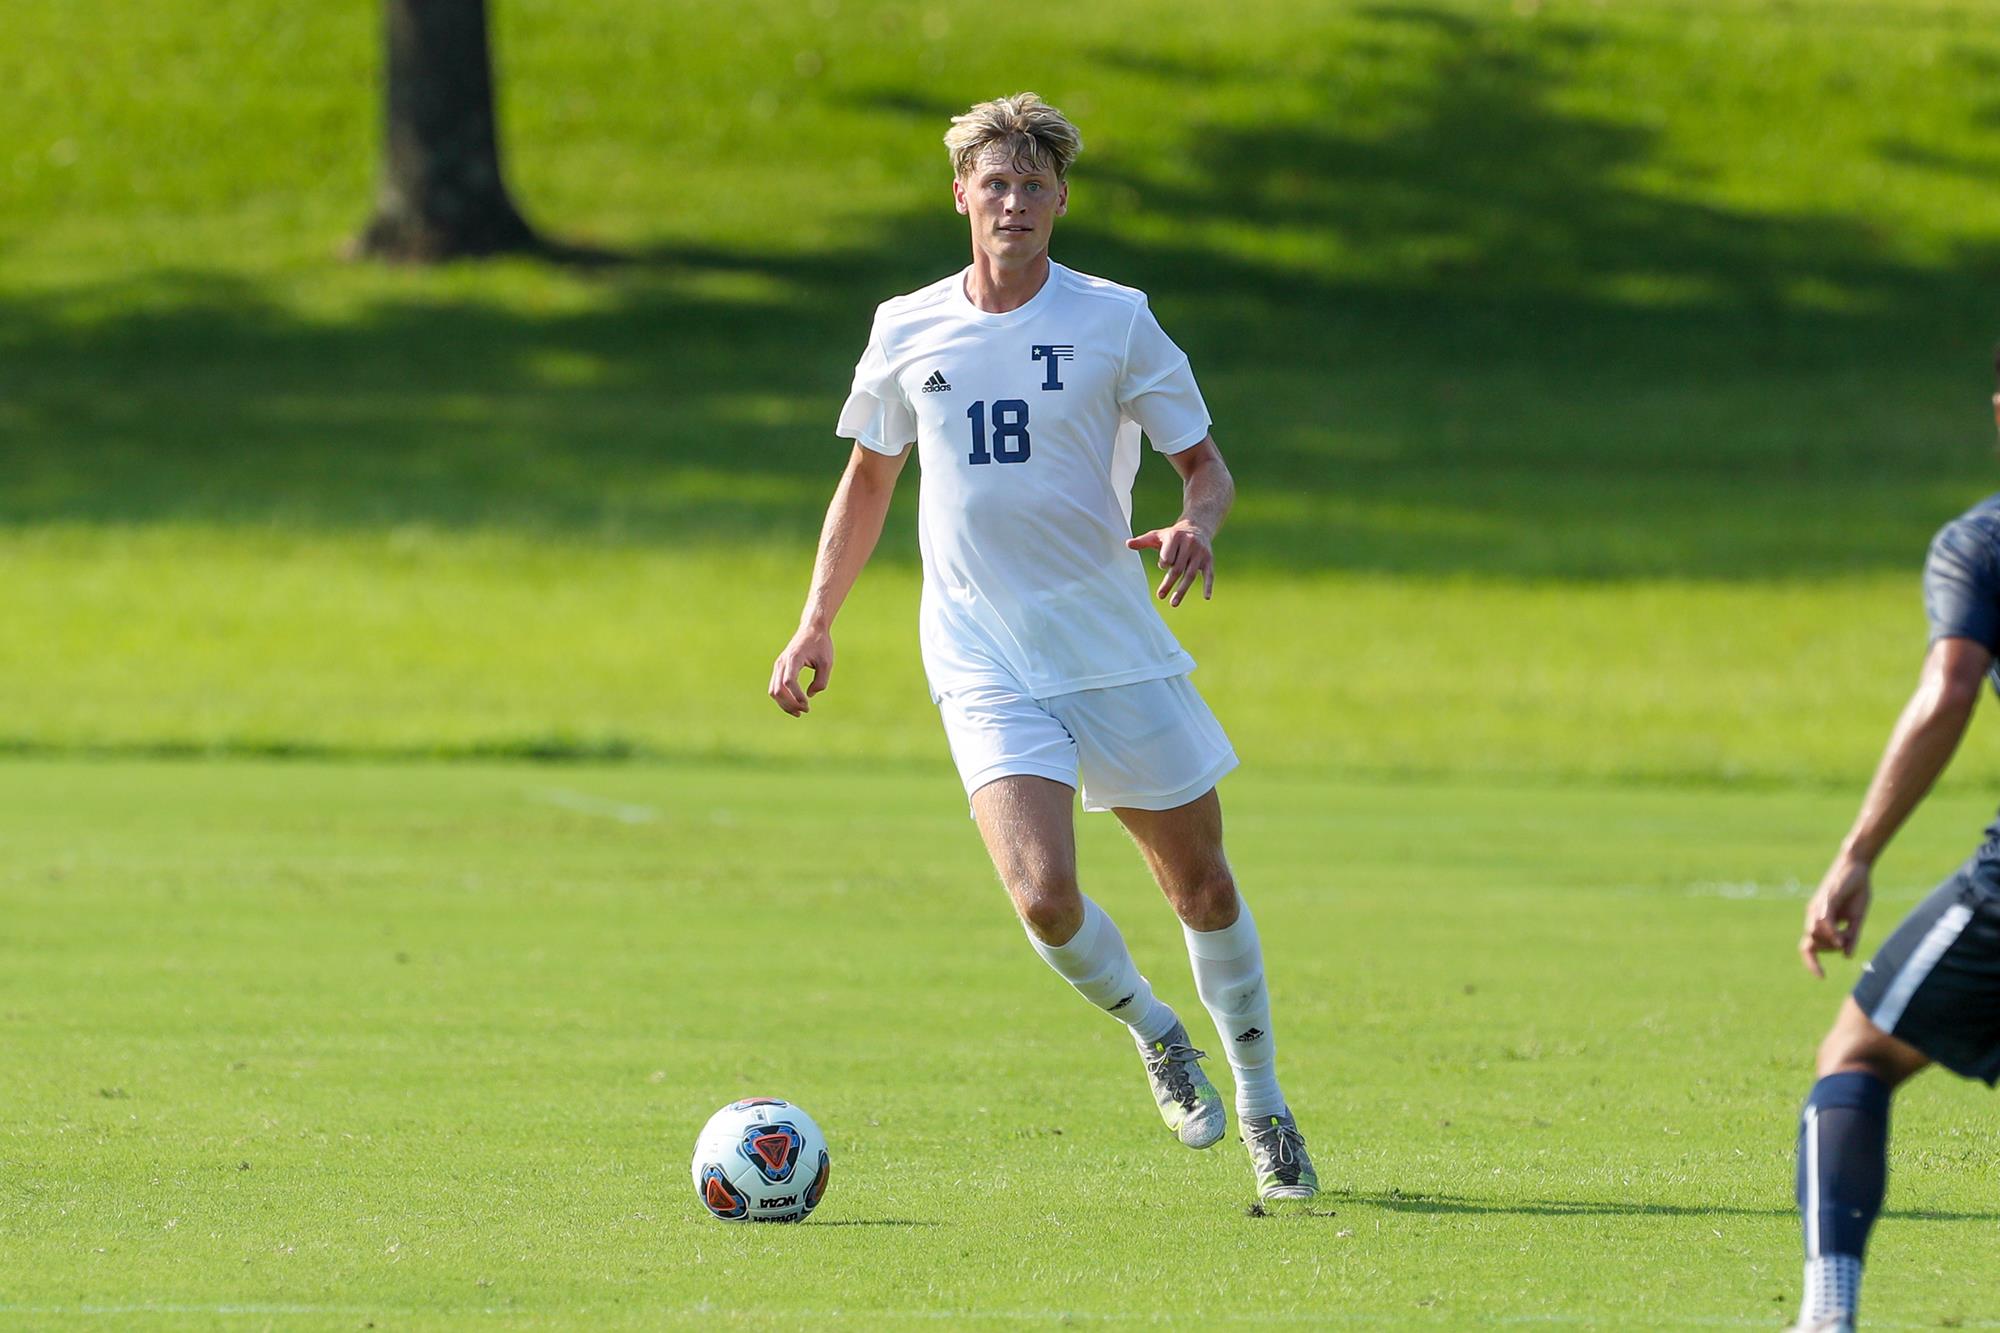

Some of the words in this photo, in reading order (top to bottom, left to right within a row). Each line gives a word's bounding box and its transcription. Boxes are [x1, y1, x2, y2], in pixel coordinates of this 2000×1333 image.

[1032, 345, 1074, 391] T
[922, 383, 951, 393] adidas
[967, 399, 1031, 465] 18
[760, 1194, 798, 1208] NCAA
